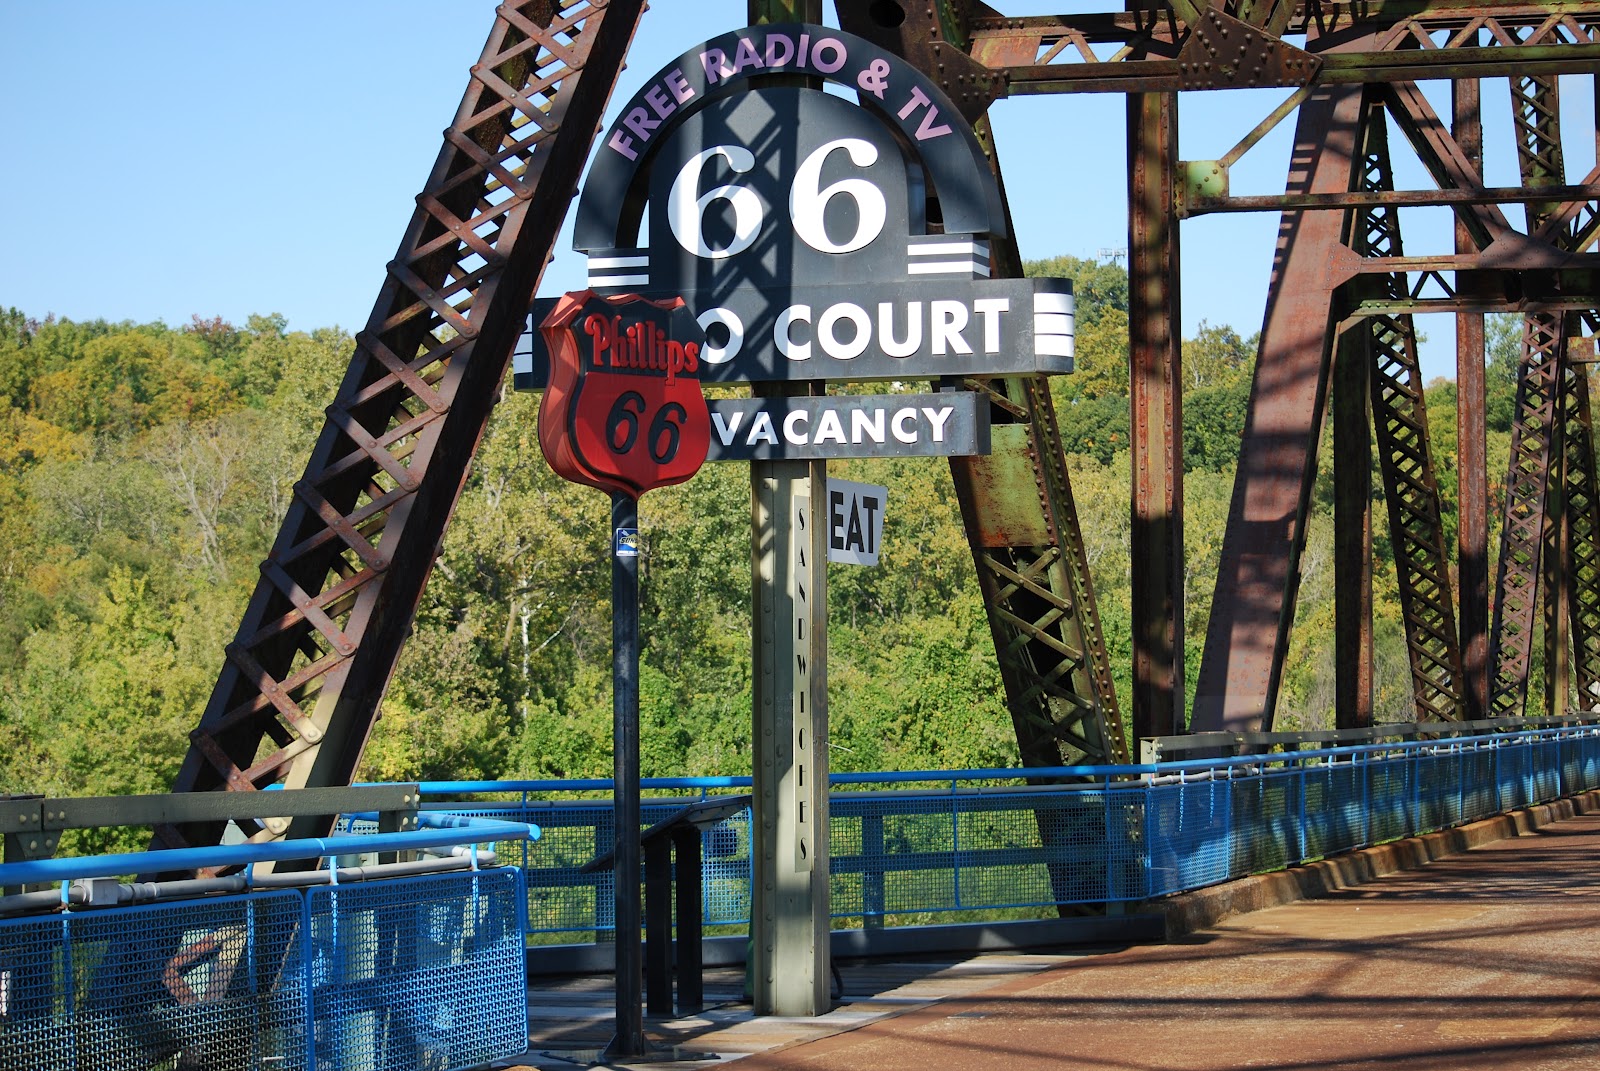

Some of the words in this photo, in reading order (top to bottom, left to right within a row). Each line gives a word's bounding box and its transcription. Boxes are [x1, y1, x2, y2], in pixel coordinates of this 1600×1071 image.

[608, 67, 696, 162] FREE
[699, 33, 848, 84] RADIO
[857, 58, 891, 100] &
[896, 85, 953, 141] TV
[667, 137, 887, 259] 66
[584, 312, 699, 386] Phillips
[773, 298, 1010, 361] COURT
[605, 390, 688, 465] 66
[710, 406, 954, 446] VACANCY
[830, 490, 879, 554] EAT
[796, 507, 810, 861] SANDWICHES
